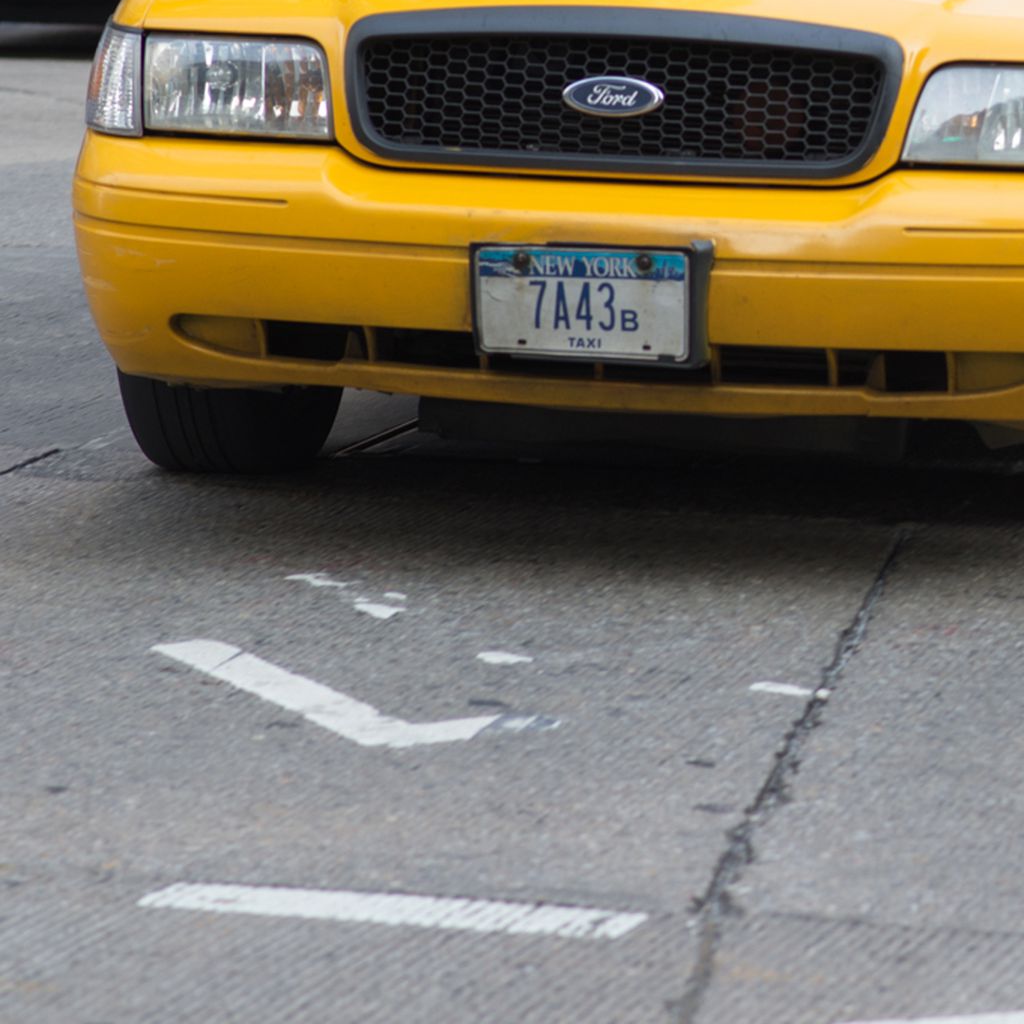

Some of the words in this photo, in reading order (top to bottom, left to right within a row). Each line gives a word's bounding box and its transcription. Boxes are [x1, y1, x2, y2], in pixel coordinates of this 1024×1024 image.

[587, 83, 639, 106] Ford
[529, 255, 577, 277] NEW
[582, 256, 637, 278] YORK
[568, 337, 602, 349] TAXI
